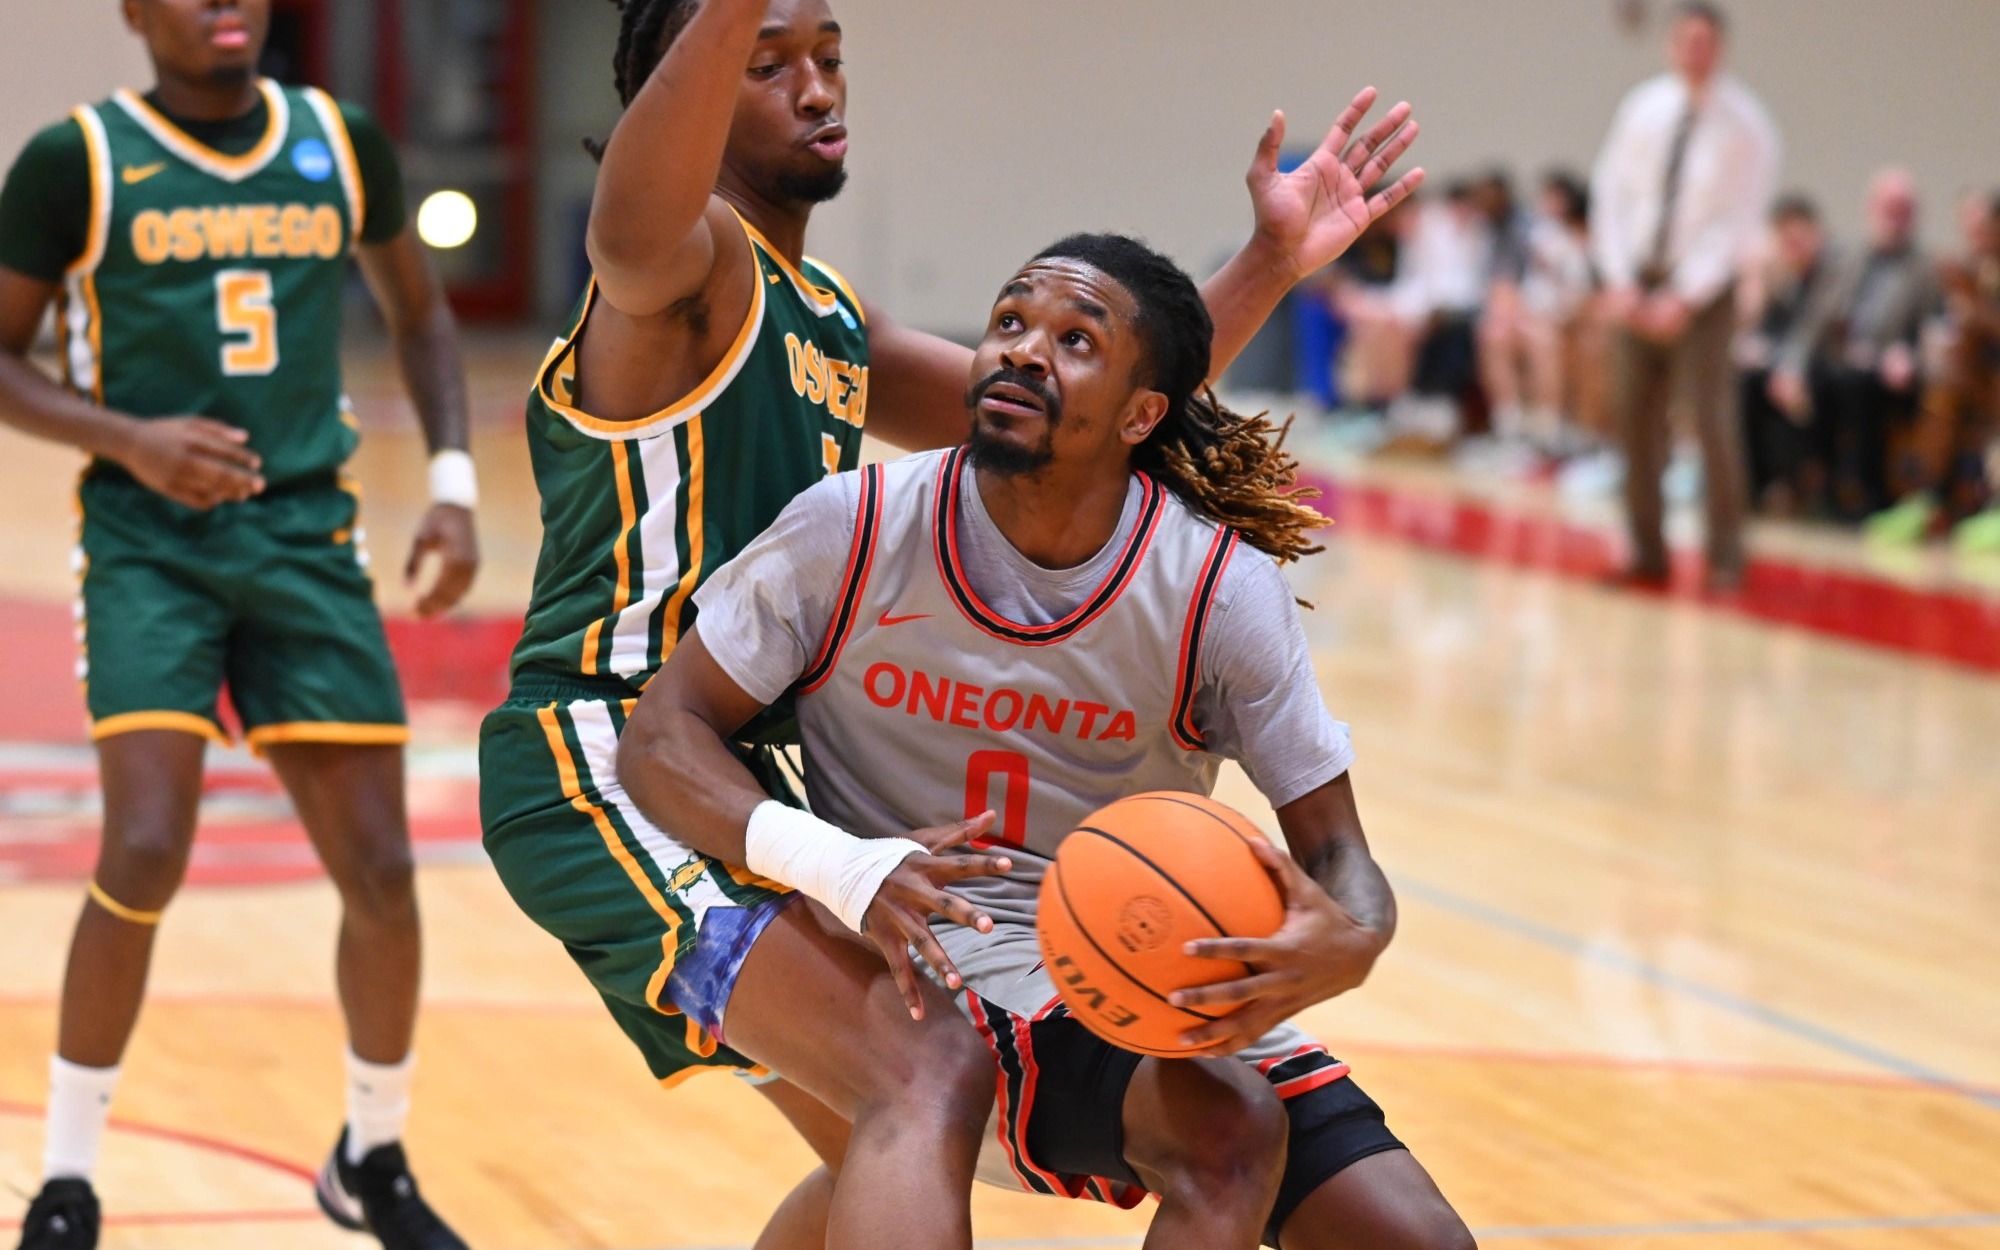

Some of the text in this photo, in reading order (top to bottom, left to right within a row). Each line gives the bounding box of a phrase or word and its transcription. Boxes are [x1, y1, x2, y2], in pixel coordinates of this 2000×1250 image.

[131, 204, 342, 264] OSWEGO
[214, 269, 279, 375] 5
[863, 662, 1136, 742] ONEONTA
[964, 749, 1029, 849] 0
